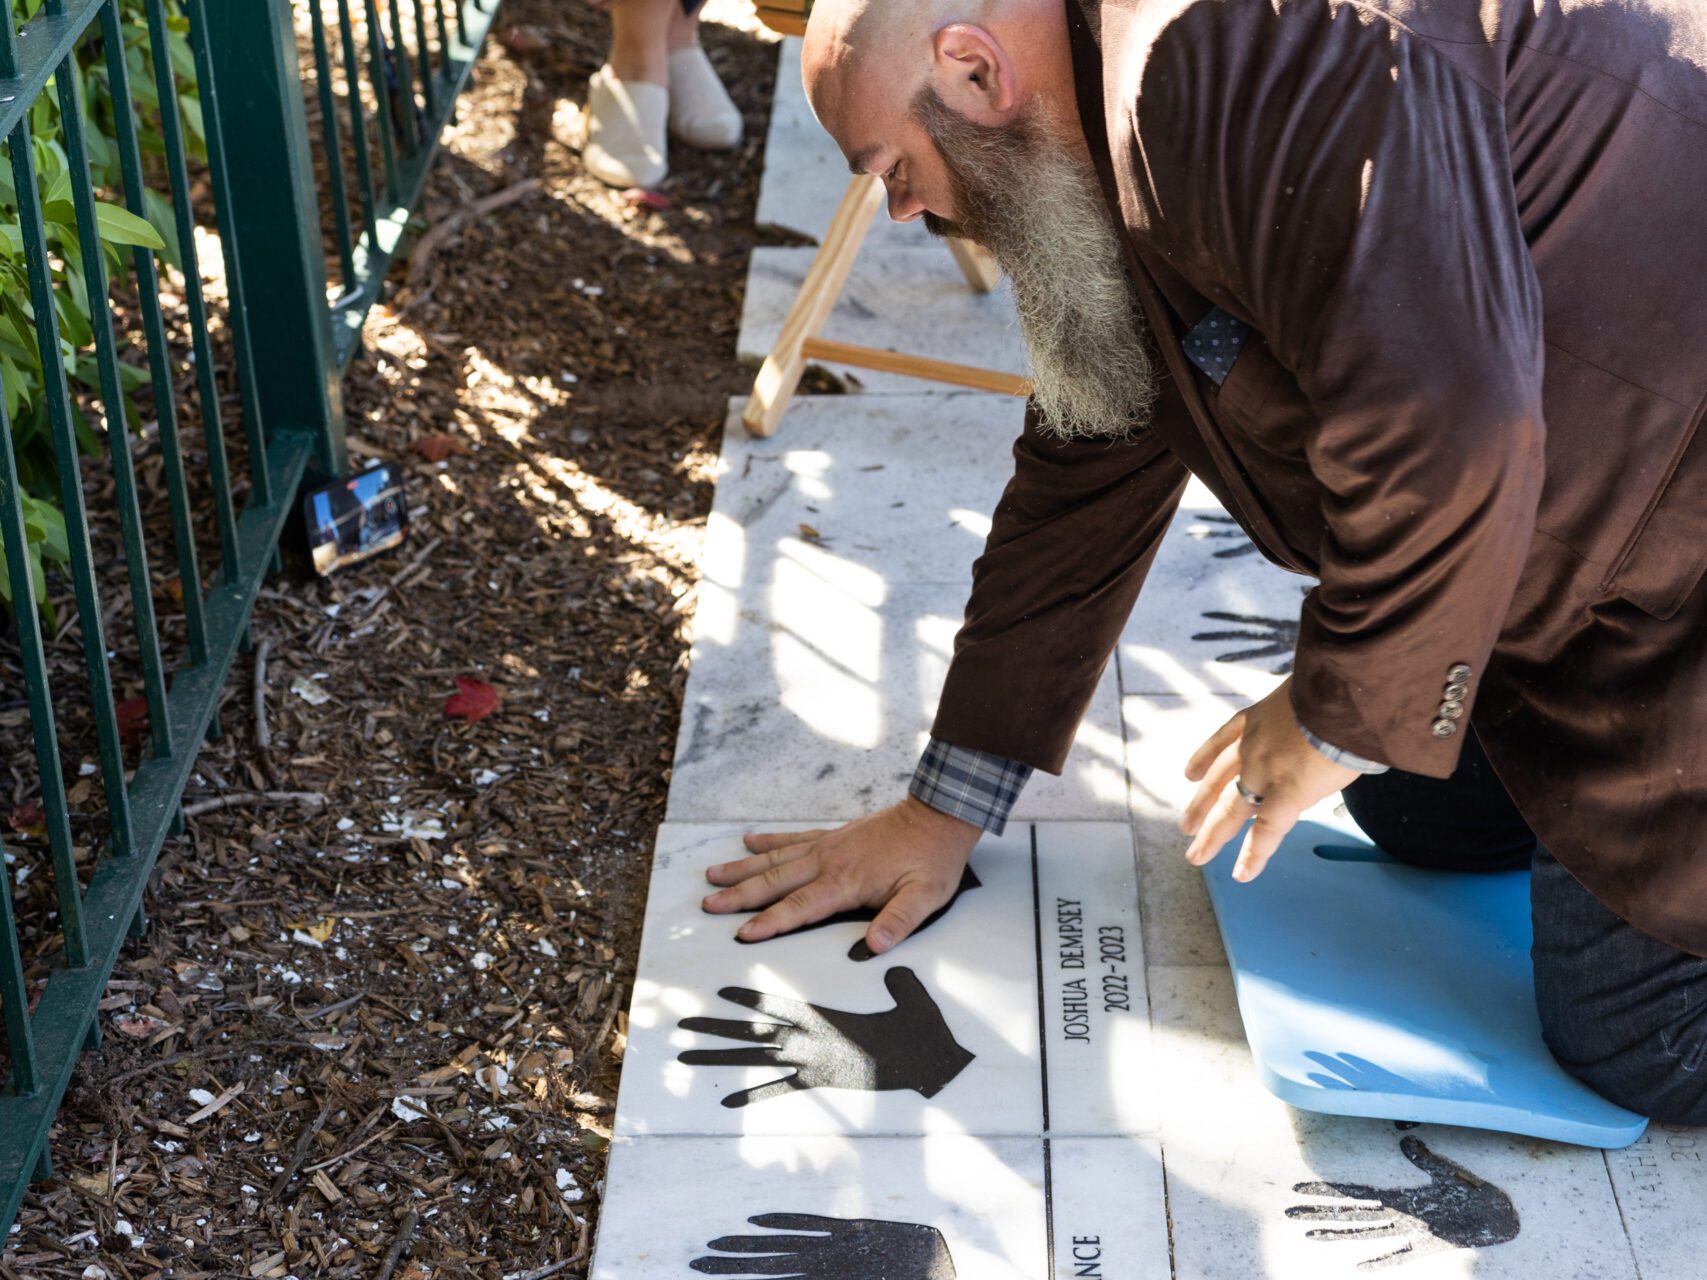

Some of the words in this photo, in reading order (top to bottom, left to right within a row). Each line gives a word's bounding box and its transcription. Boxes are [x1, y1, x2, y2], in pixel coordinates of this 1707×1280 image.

[1056, 897, 1086, 969] DEMPSEY
[1098, 925, 1130, 1012] 2022-2023
[1062, 977, 1091, 1045] JOSHUA
[1072, 1235, 1102, 1280] NCE
